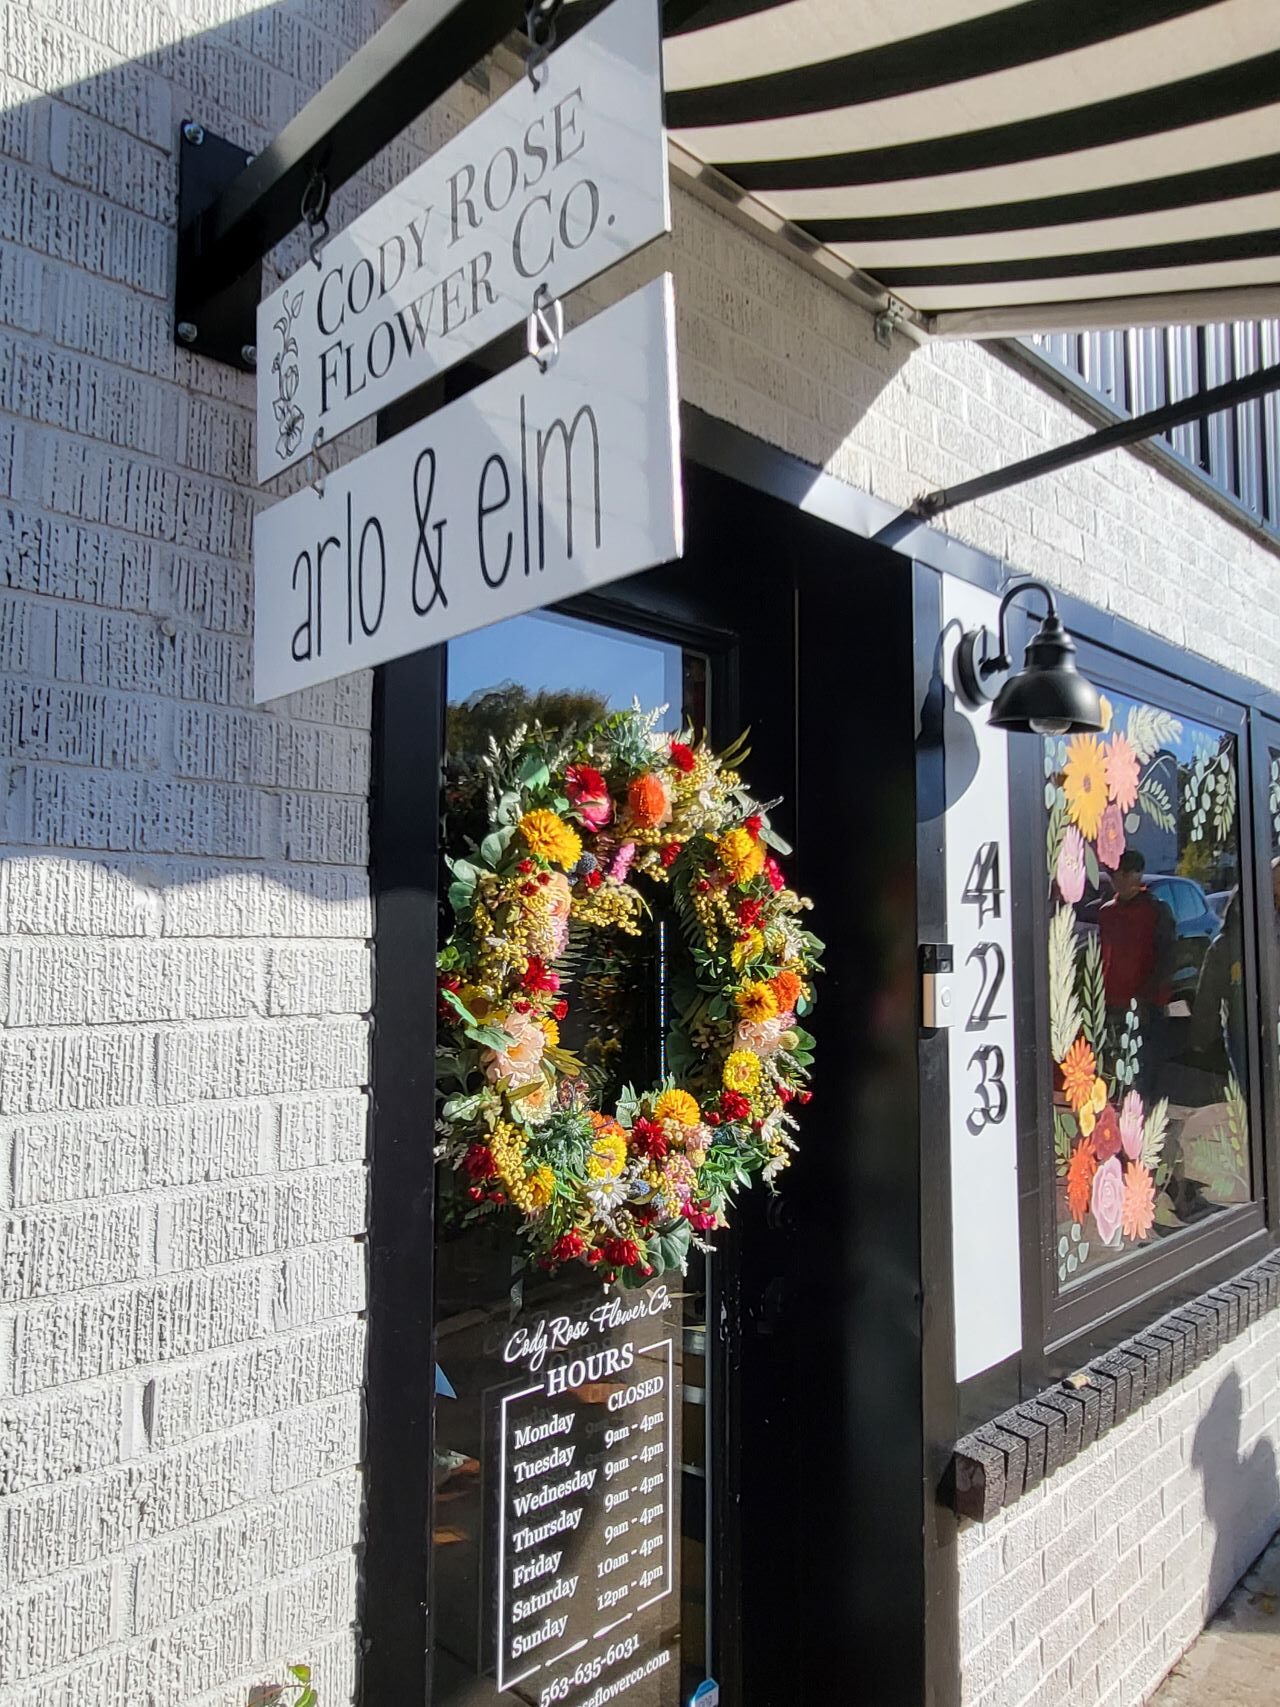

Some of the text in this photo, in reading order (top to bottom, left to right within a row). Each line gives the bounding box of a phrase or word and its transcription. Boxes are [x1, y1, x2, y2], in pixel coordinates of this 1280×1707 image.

[316, 88, 585, 335] CODY ROSE
[318, 178, 616, 418] FLOWER CO.
[291, 394, 601, 662] arlo & elm
[964, 841, 1007, 1128] 423
[504, 1285, 672, 1371] Cody Rose Flower Co.
[547, 1343, 634, 1397] HOURS
[513, 1445, 576, 1484] Tuesday
[605, 1426, 630, 1449] 9am
[640, 1411, 664, 1432] 4pm
[514, 1376, 664, 1450] Monday CLOSED
[512, 1508, 584, 1553] Thursday
[605, 1489, 629, 1513] 9am
[640, 1473, 664, 1494] 4pm
[513, 1469, 597, 1518] Wednesday
[605, 1457, 630, 1481] 9am
[640, 1442, 664, 1463] 4pm
[512, 1575, 579, 1624] Saturday
[597, 1553, 629, 1578] 10am
[640, 1534, 664, 1557] 4pm
[513, 1551, 563, 1589] Friday
[605, 1521, 629, 1545] 9am
[640, 1503, 664, 1526] 4pm
[512, 1615, 568, 1659] Sunday
[597, 1585, 628, 1611] 12pm
[640, 1565, 663, 1588] 4pm
[541, 1633, 640, 1707] 563-635-6031
[577, 1650, 671, 1707] seflowerco.com
